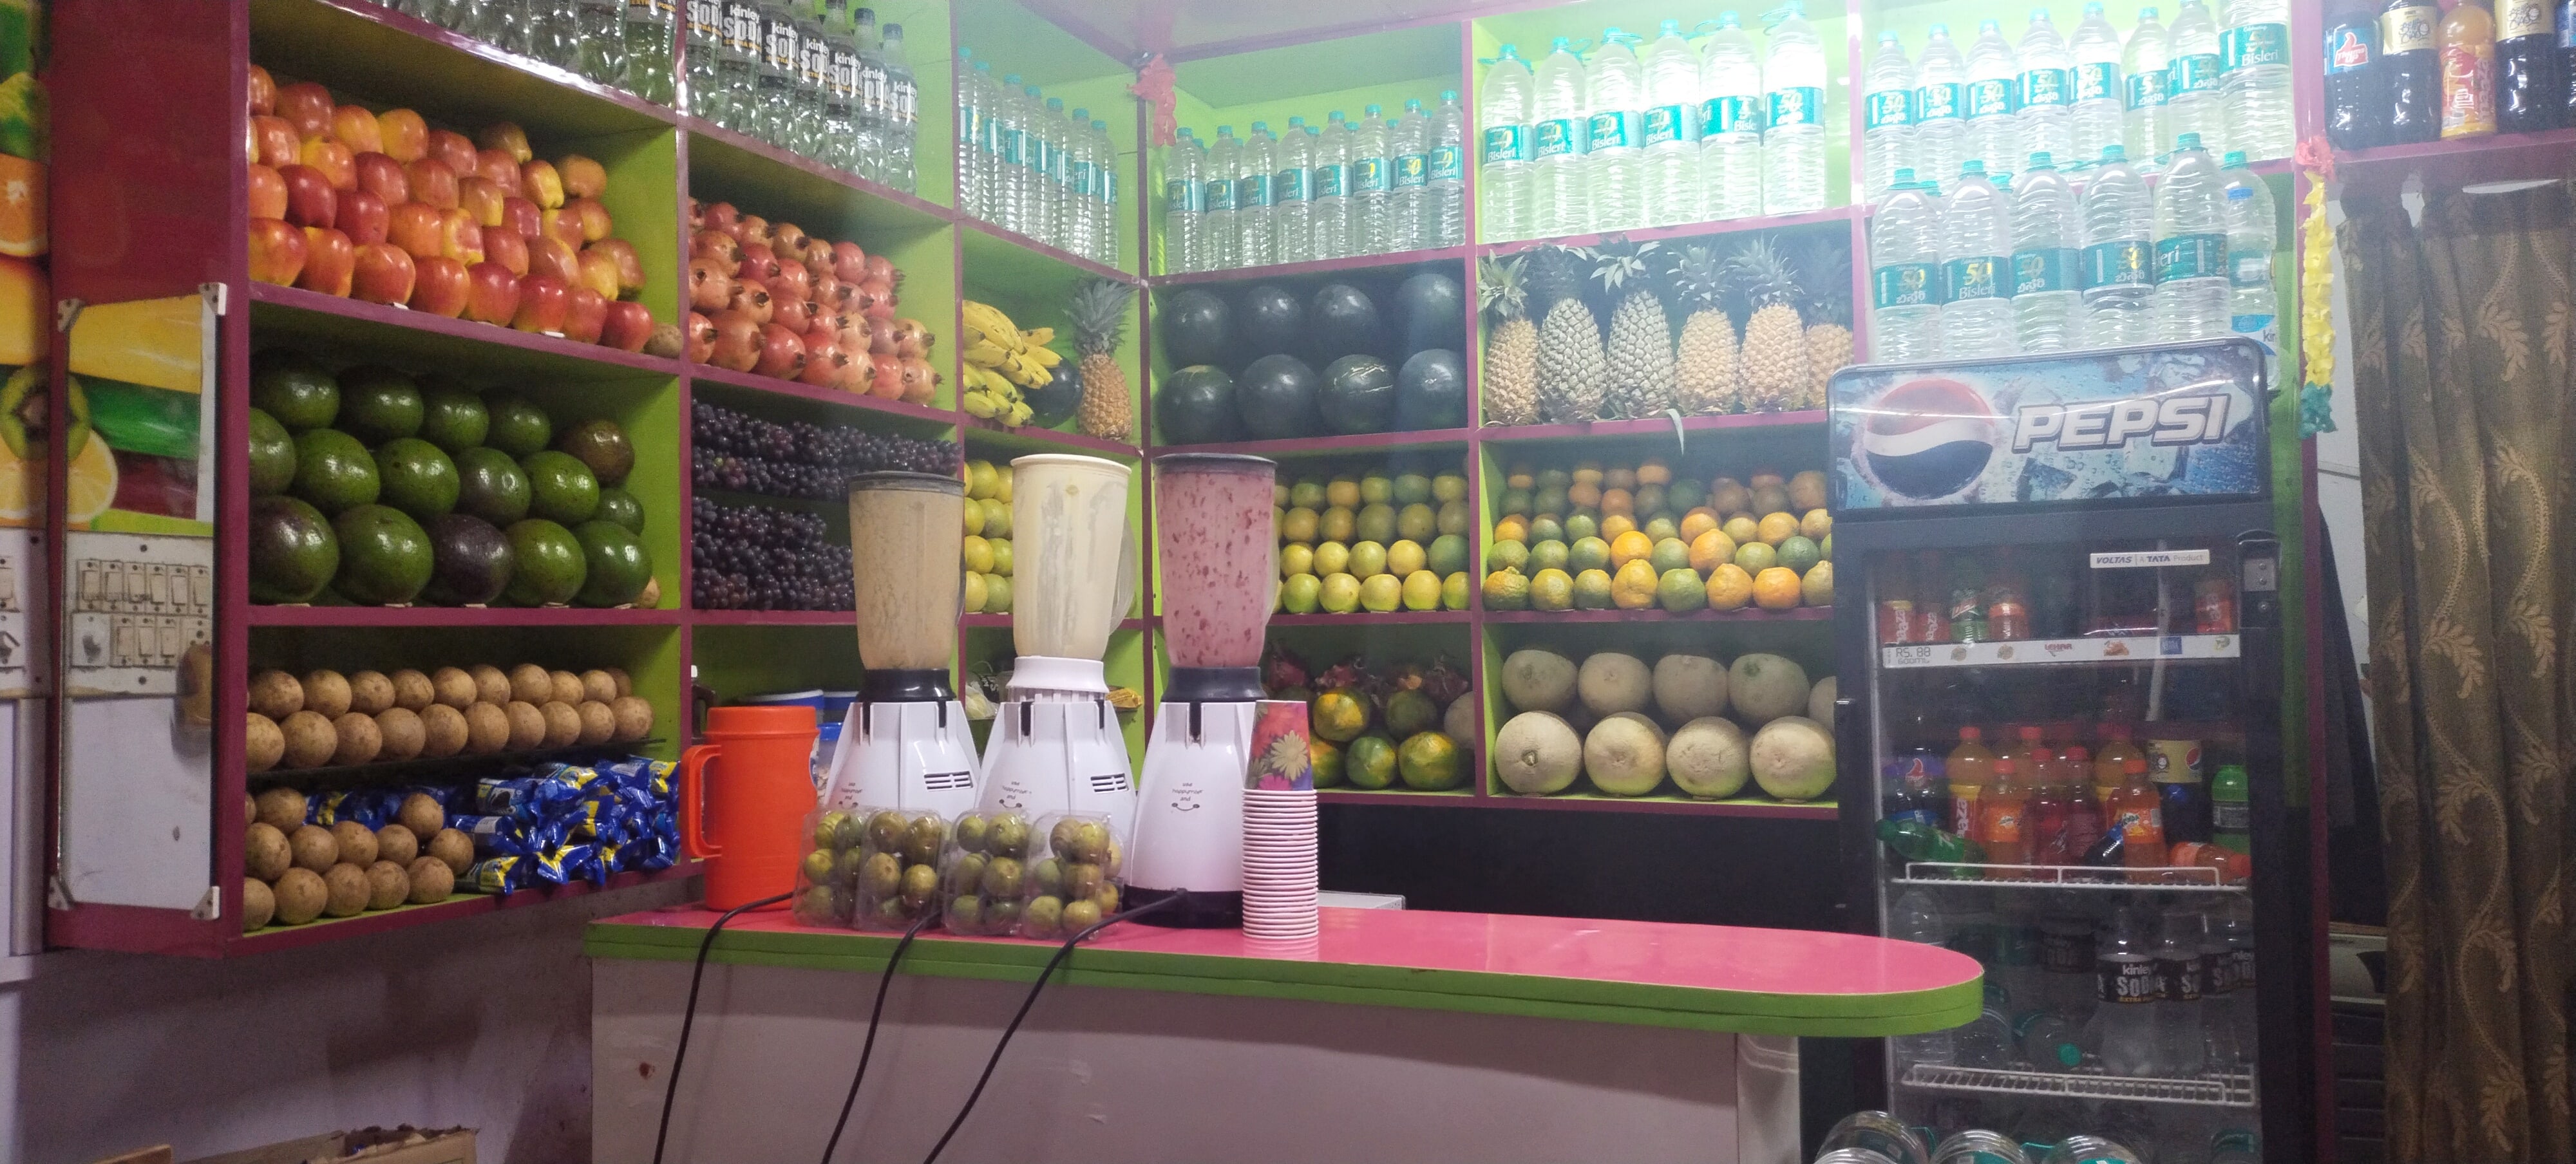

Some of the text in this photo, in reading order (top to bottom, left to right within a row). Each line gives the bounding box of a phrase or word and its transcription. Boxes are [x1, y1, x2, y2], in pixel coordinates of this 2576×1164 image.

[730, 5, 760, 24] kinley
[771, 22, 799, 42] kinley
[806, 37, 829, 56] kinley
[835, 52, 861, 70] kinley
[2241, 49, 2278, 67] Bisleri
[894, 81, 918, 97] kinley
[1592, 133, 1621, 151] Bisleri
[1646, 127, 1674, 145] Bisleri
[1488, 147, 1517, 162] Bisleri
[1538, 141, 1566, 156] Bisleri
[1399, 174, 1425, 185] Bisleri
[1430, 167, 1456, 180] Bisleri
[1965, 262, 1993, 286] 50
[1958, 282, 1996, 300] Bisleri
[2012, 395, 2230, 453] PEPSI
[2096, 556, 2132, 564] VOLTAS
